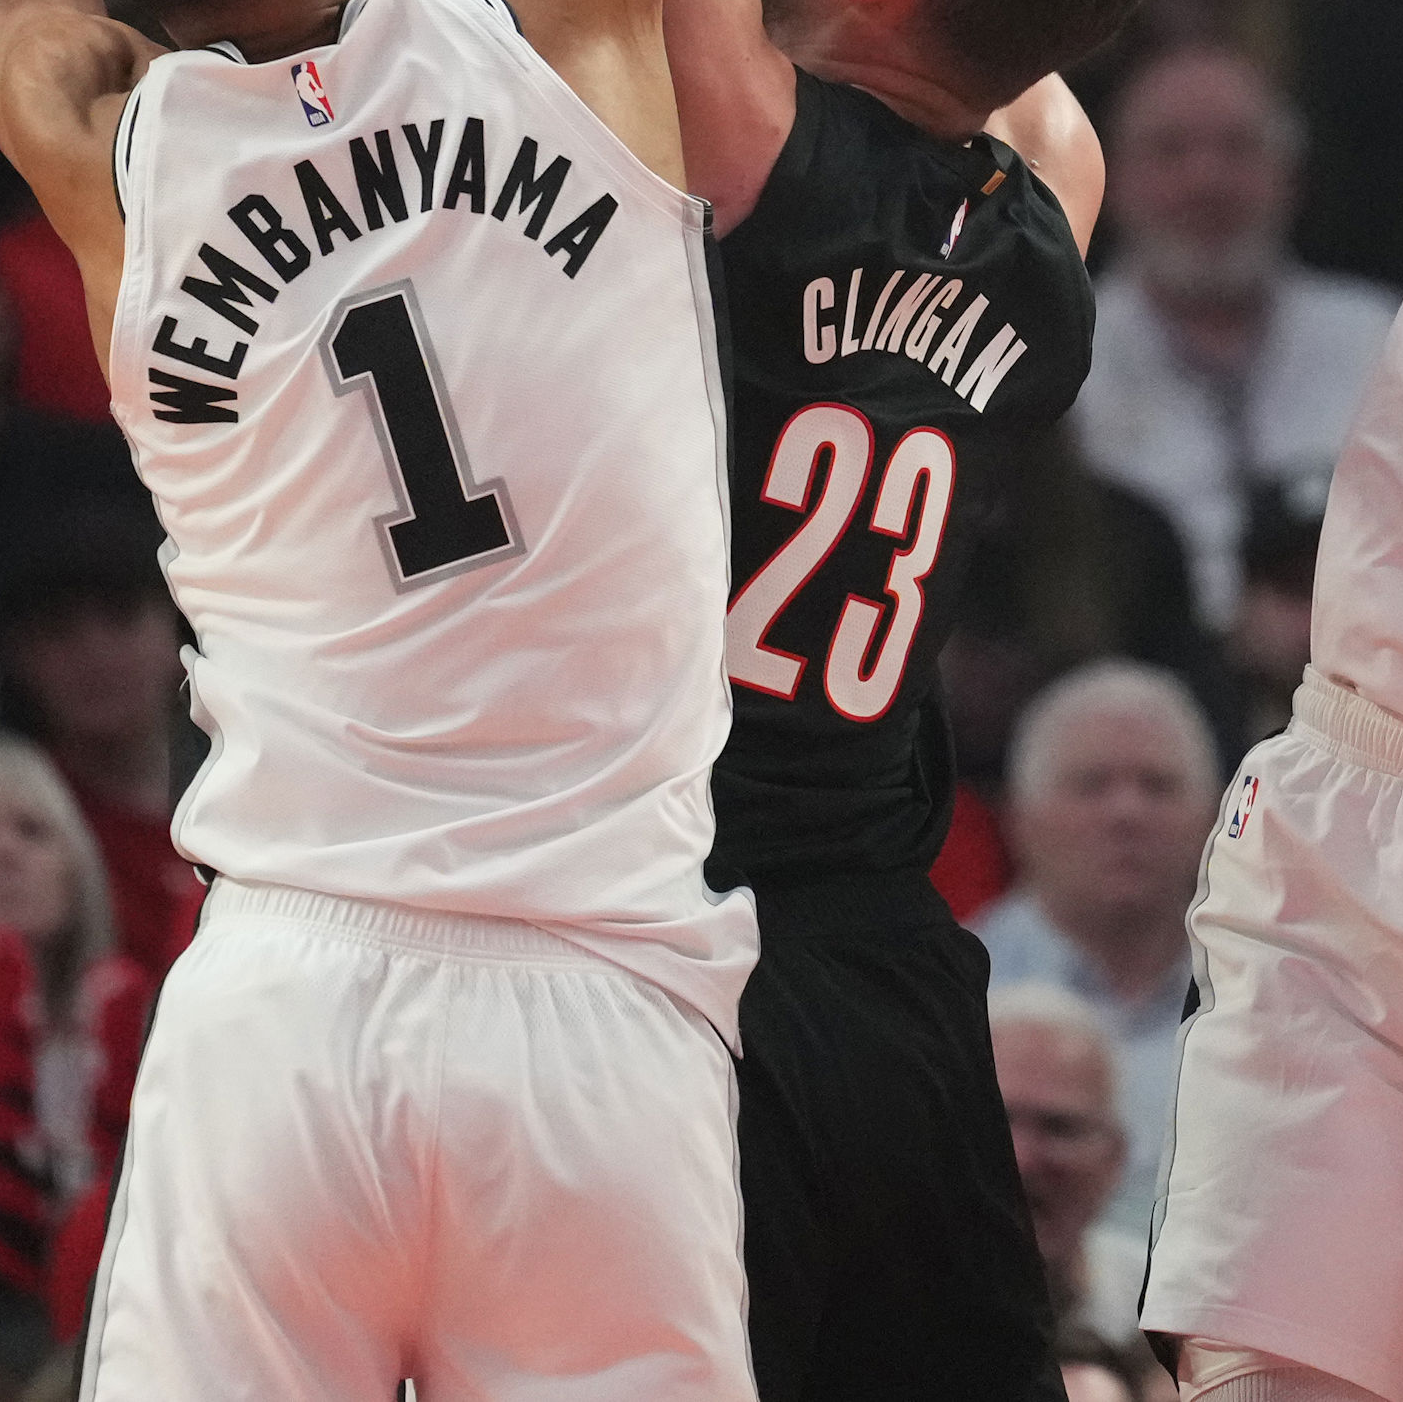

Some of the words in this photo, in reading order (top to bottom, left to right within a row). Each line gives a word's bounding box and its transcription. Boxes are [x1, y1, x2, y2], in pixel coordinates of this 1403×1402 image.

[148, 116, 619, 427] WEMBANYAMA
[802, 267, 1028, 414] CLINGAN
[319, 278, 527, 594] 1
[726, 401, 957, 722] 23
